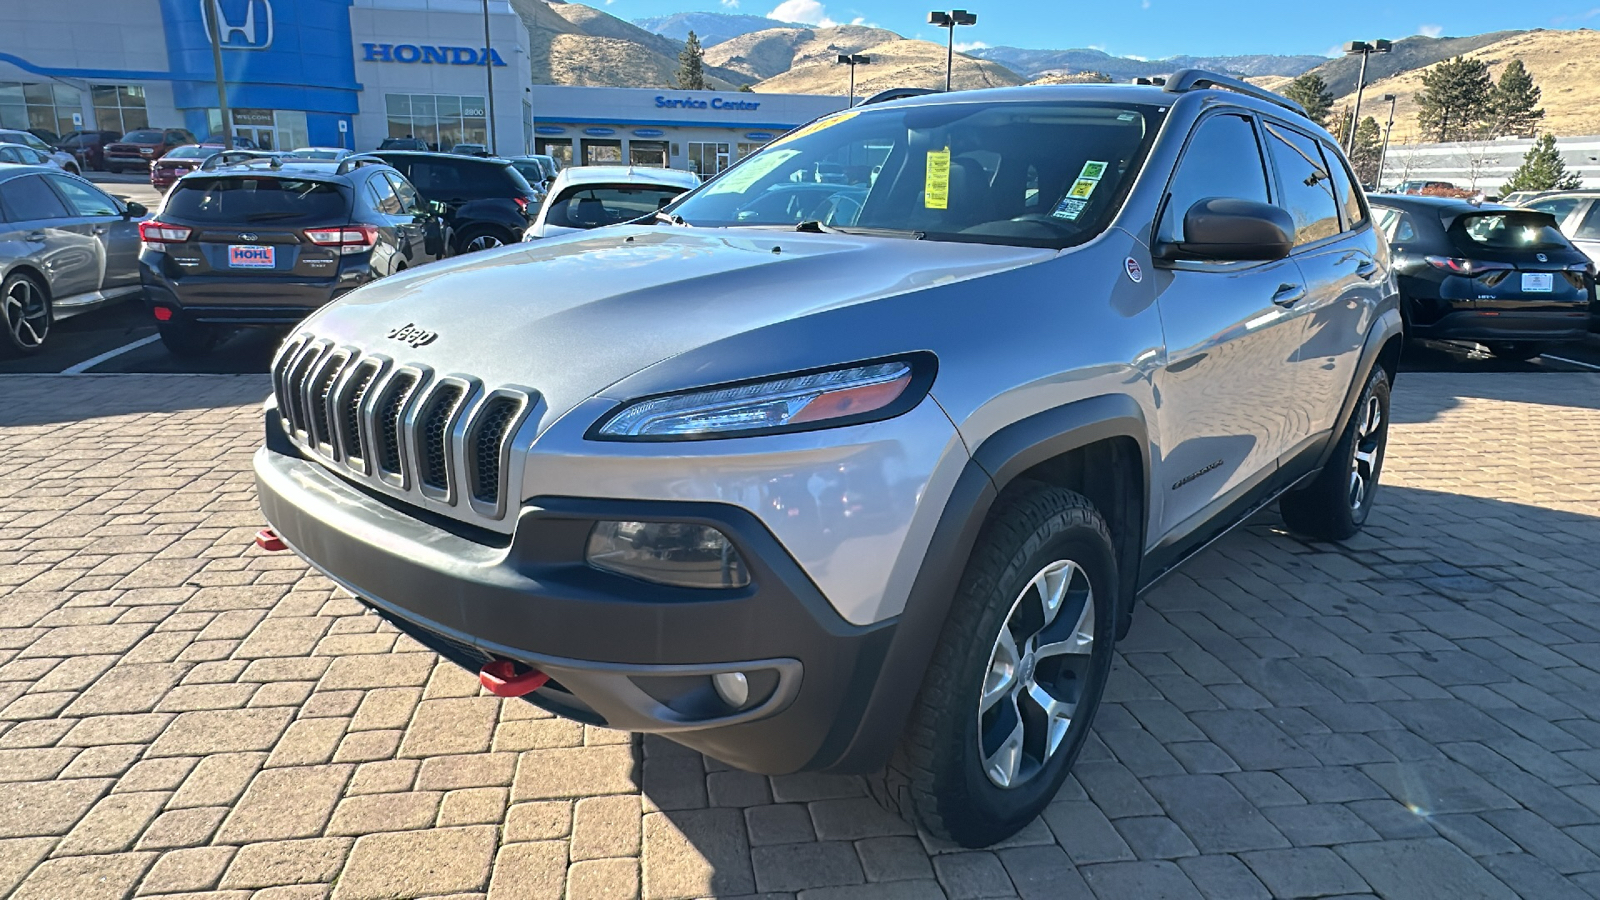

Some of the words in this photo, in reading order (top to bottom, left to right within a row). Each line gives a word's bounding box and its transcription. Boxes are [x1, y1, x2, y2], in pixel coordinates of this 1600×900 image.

[361, 43, 508, 66] HONDA
[655, 96, 707, 109] Service
[711, 98, 760, 111] Center
[234, 250, 270, 259] HOHL
[387, 322, 439, 349] Jeep
